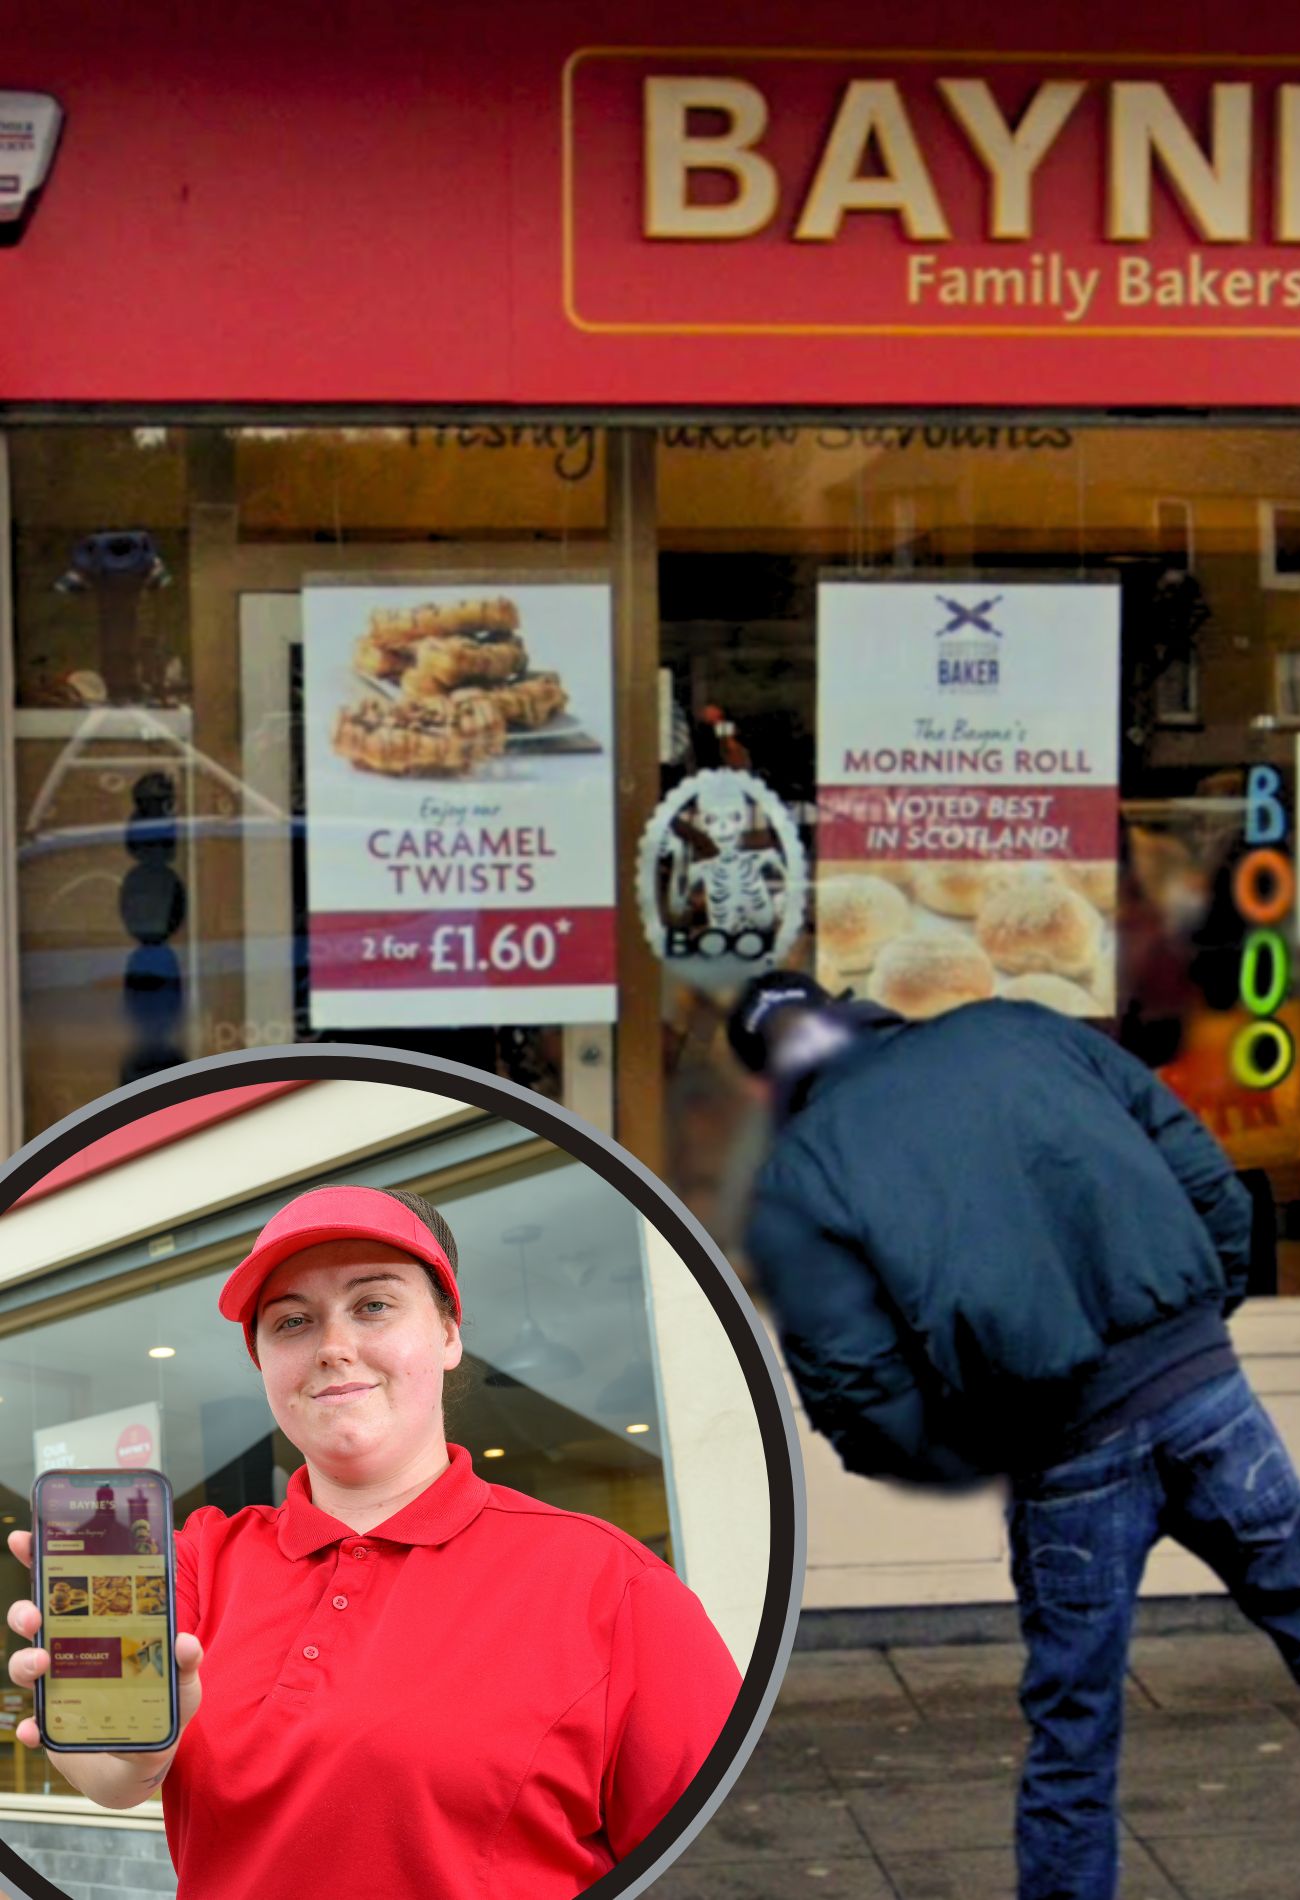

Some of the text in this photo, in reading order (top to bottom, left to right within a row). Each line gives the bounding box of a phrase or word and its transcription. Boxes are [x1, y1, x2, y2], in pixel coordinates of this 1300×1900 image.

[906, 253, 1100, 321] Family
[937, 659, 999, 685] BAKER
[914, 718, 946, 741] The
[844, 750, 1092, 773] MORNING ROLL
[419, 796, 467, 825] Enjoy
[886, 796, 1054, 820] VOTED BEST
[367, 827, 557, 860] CARAMEL
[866, 826, 1071, 850] IN SCOTLAND!
[387, 862, 537, 894] TWISTS
[361, 936, 376, 961] 2
[382, 934, 420, 960] for
